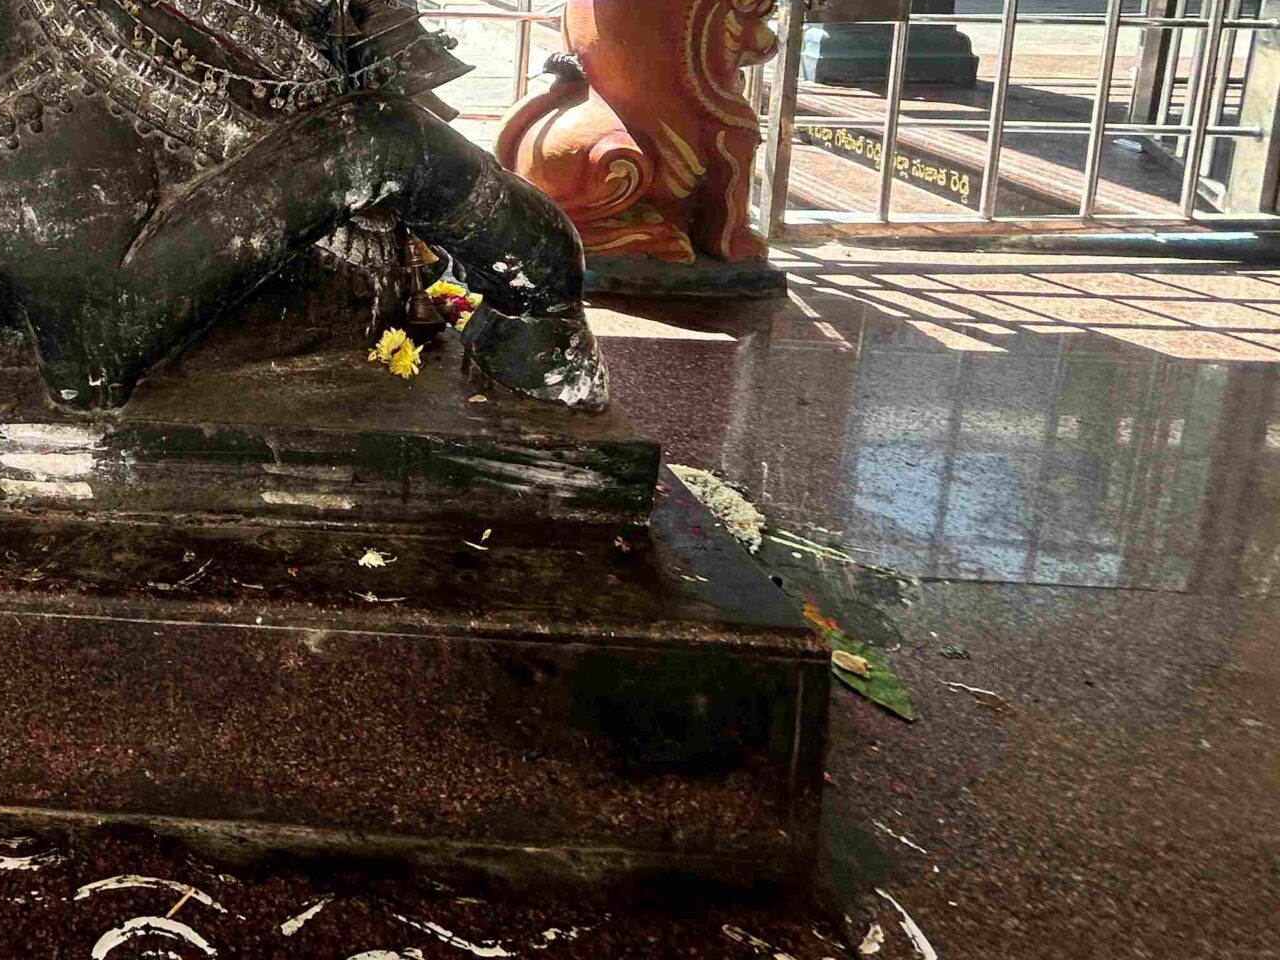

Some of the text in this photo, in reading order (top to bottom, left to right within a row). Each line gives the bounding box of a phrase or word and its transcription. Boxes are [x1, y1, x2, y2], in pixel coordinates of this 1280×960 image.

[834, 128, 866, 155] గోపాల్
[912, 158, 947, 187] సుజాత
[950, 170, 970, 204] రెడ్డి
